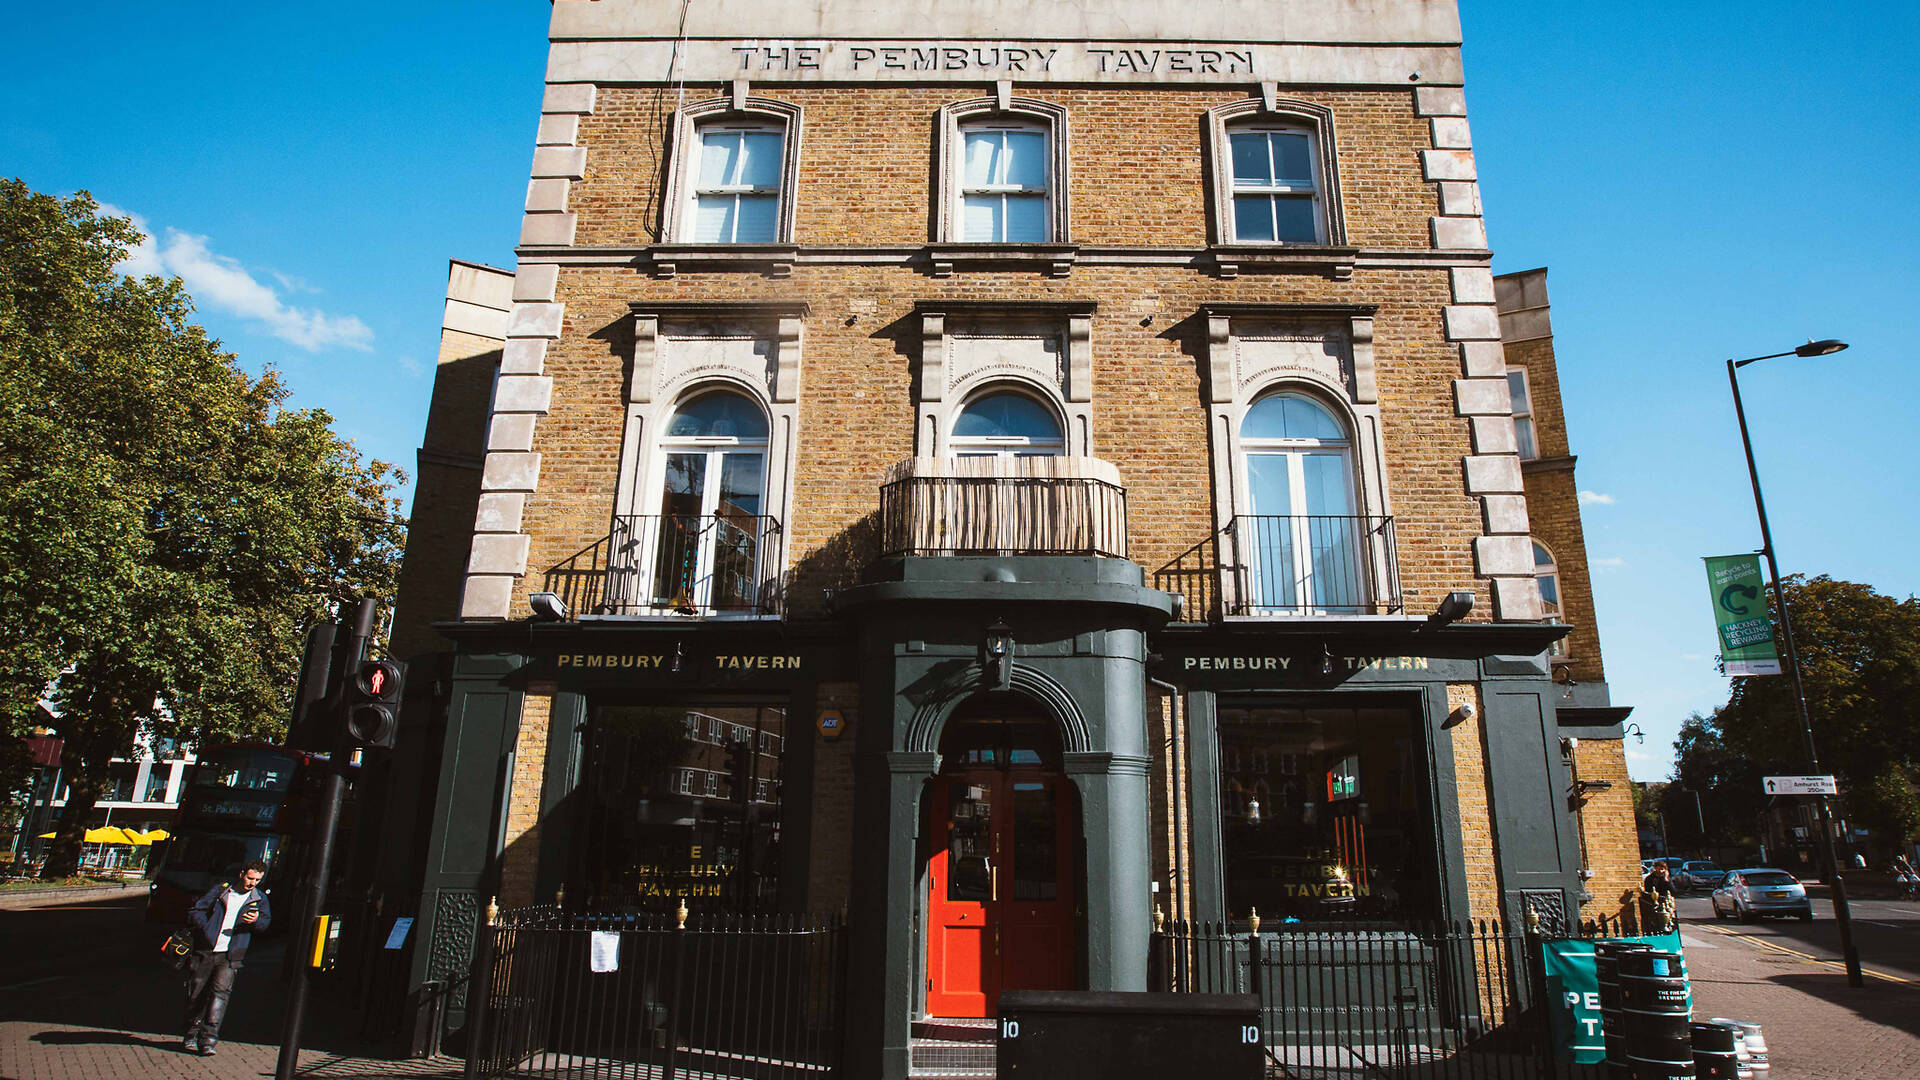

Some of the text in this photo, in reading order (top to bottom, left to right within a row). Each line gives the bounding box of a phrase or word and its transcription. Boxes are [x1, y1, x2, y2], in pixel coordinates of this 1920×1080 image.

[731, 47, 1254, 74] THE PEMBURY TAVERN
[1724, 625, 1769, 640] RECYCLING
[1725, 620, 1761, 632] HACKNEY
[1731, 632, 1769, 646] REWARDS
[557, 654, 801, 669] PEMBURY TAVERN
[1184, 656, 1429, 670] PEMBURY TAVERN
[823, 719, 839, 728] ADT
[1283, 883, 1370, 897] TAVERN
[1002, 1018, 1019, 1038] 10
[1241, 1025, 1259, 1044] 10
